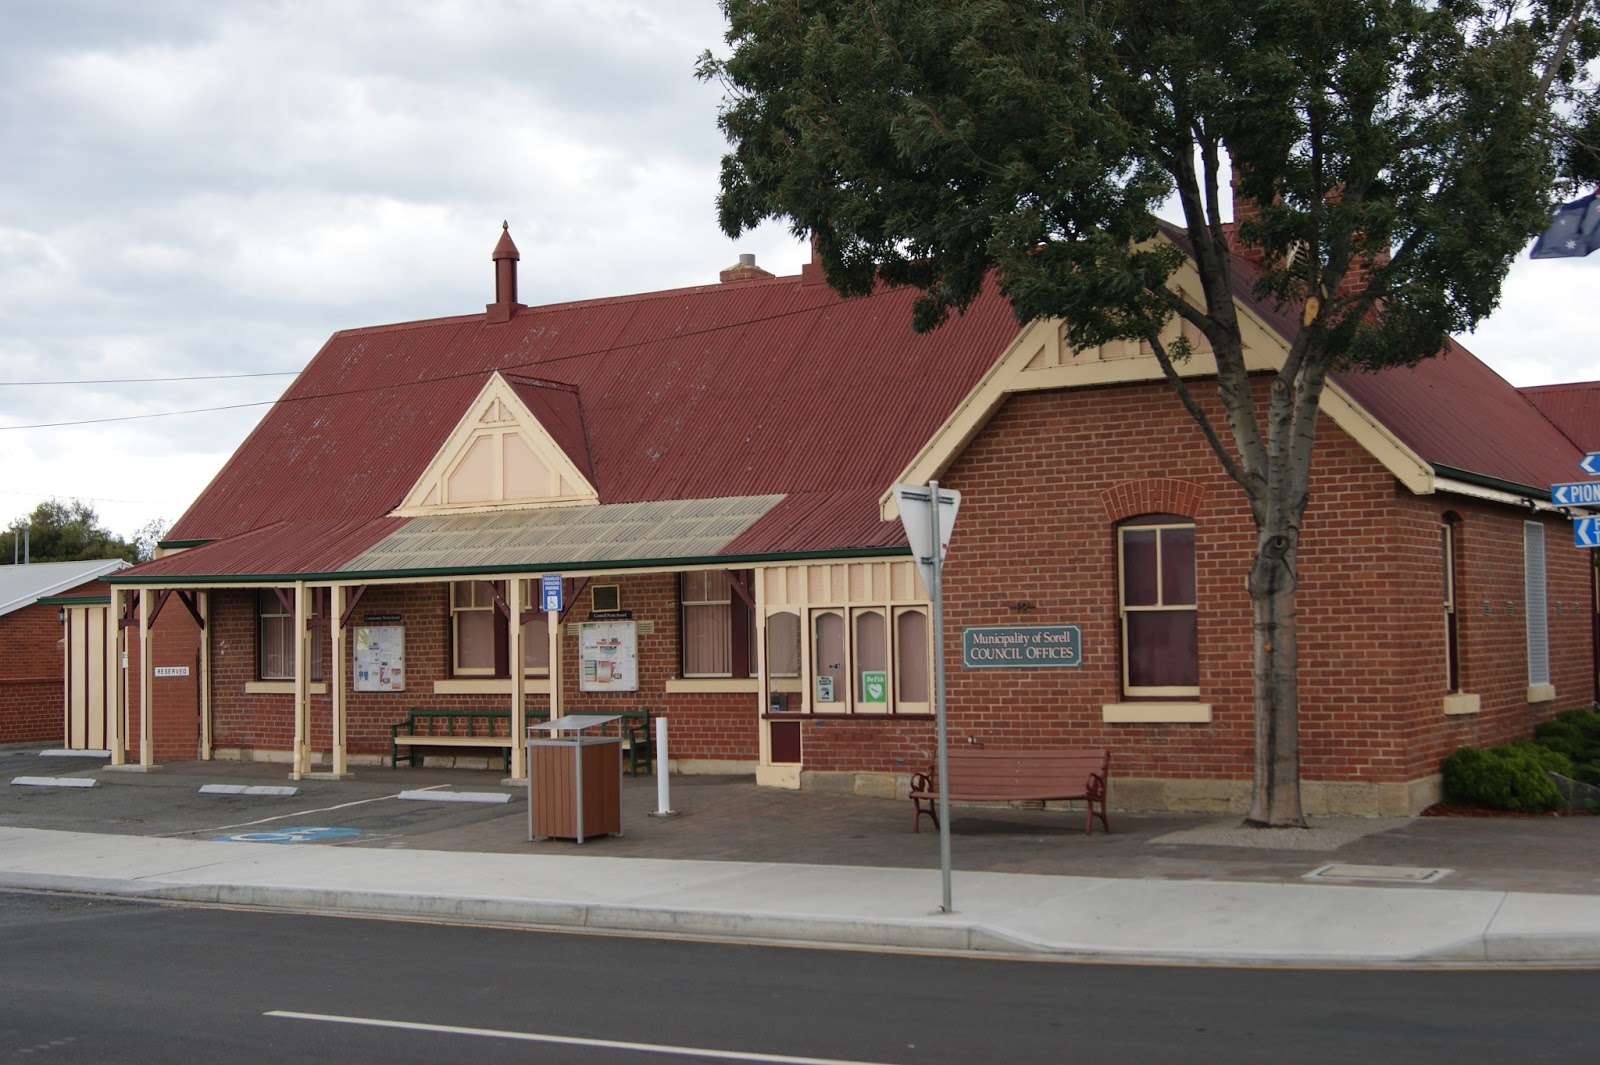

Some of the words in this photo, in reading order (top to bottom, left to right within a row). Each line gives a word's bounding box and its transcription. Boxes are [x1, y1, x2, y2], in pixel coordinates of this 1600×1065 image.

[1571, 484, 1600, 502] PION
[973, 633, 1030, 647] Municipality
[1032, 632, 1041, 643] of
[1043, 631, 1071, 643] Sorell
[970, 647, 1023, 660] COUNCIL
[1026, 646, 1074, 659] OFFICES
[866, 675, 884, 683] Defib
